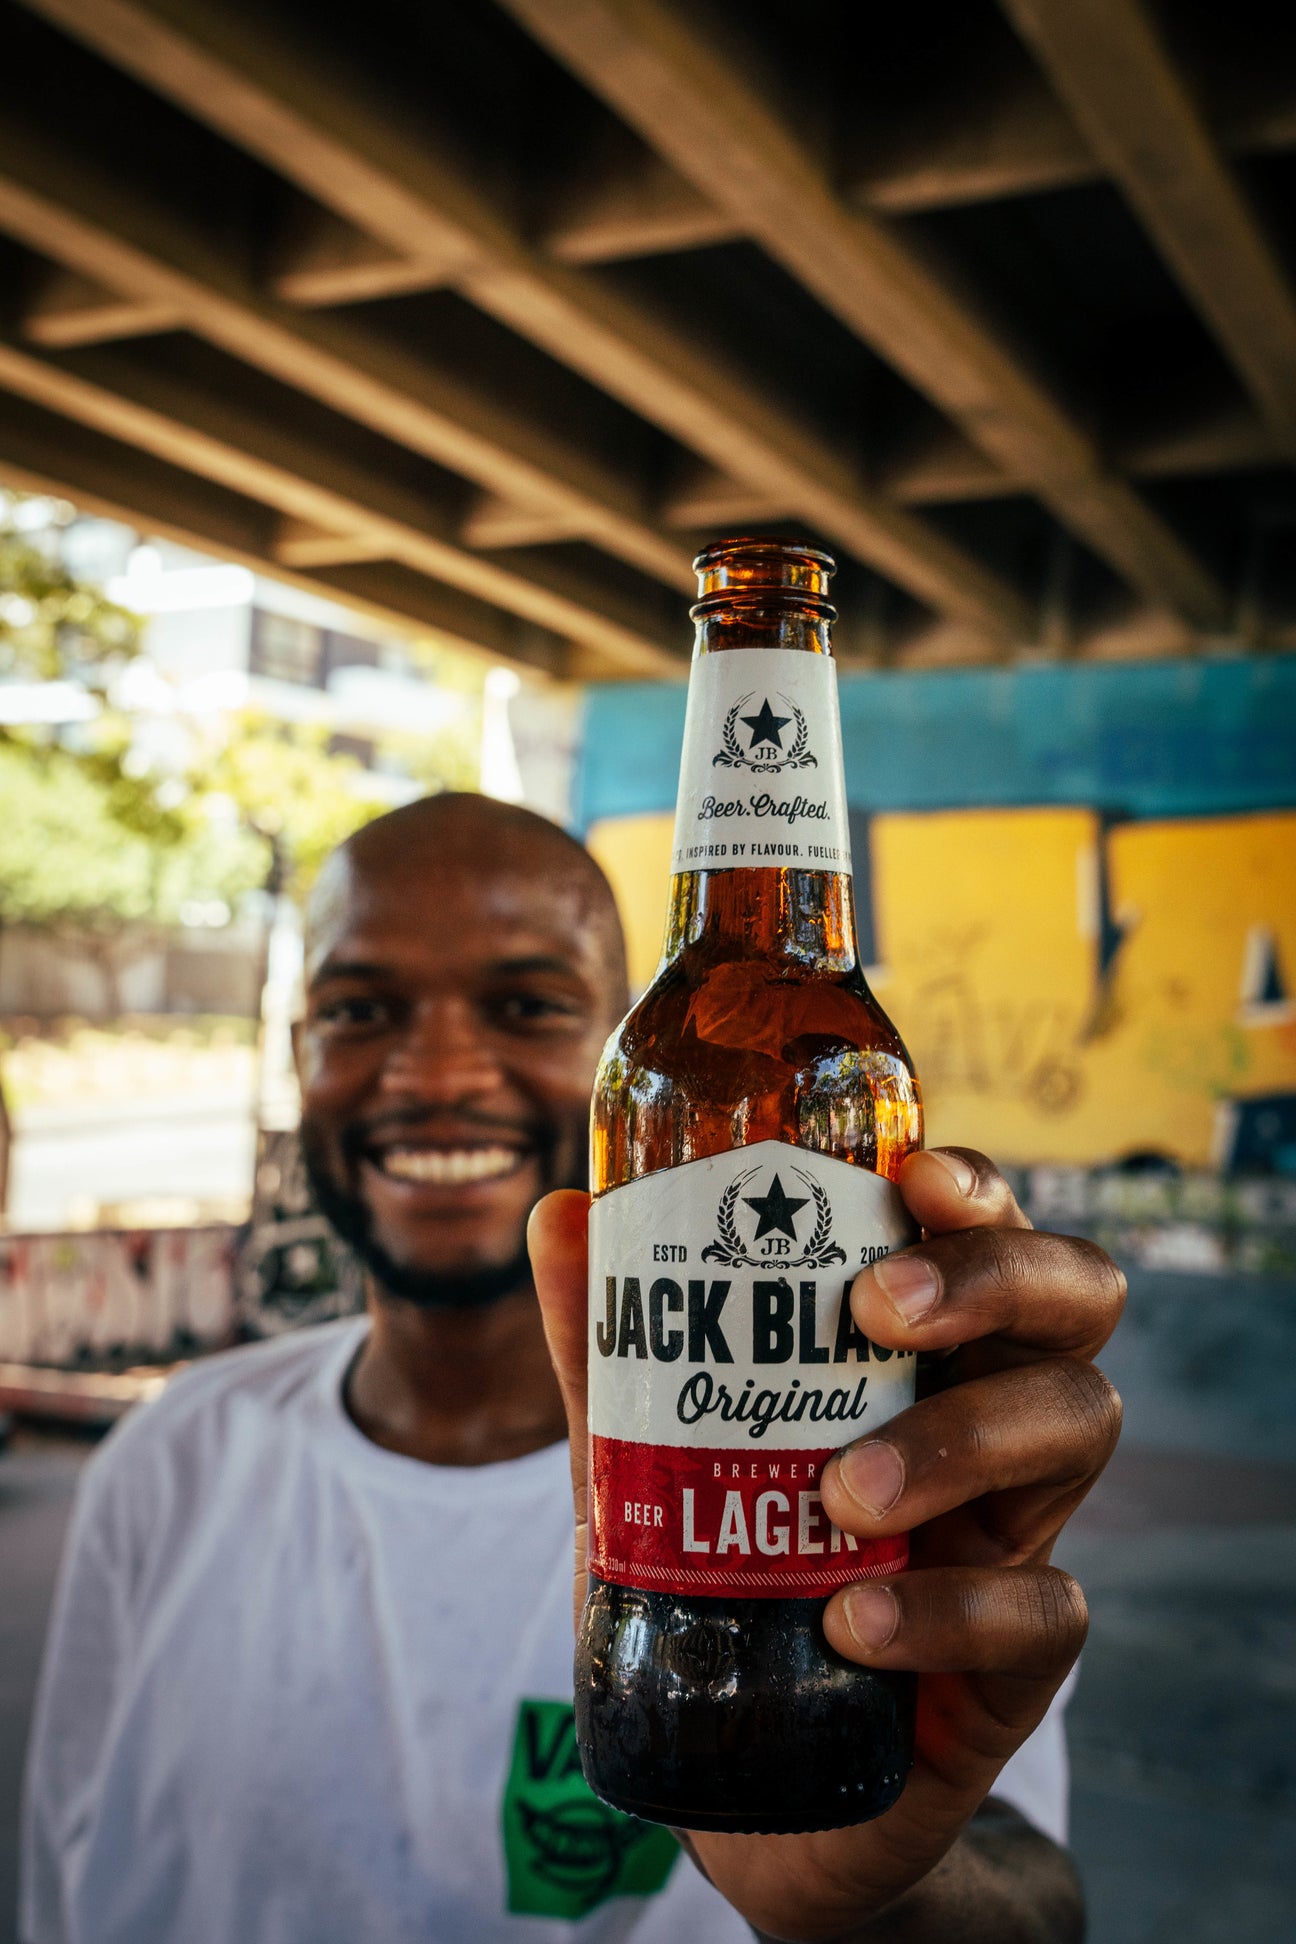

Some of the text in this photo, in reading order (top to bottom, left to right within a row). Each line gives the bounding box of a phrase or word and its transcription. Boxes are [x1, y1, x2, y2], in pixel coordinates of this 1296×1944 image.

[755, 747, 778, 760] JB
[686, 844, 727, 859] INSPIRED
[732, 843, 746, 856] BY
[751, 843, 803, 857] FLAVOUR.
[653, 1244, 687, 1263] ESTD
[760, 1238, 791, 1255] JB
[596, 1275, 914, 1364] JACK BLA
[676, 1371, 868, 1438] Original
[713, 1463, 816, 1479] BREWER
[624, 1501, 664, 1527] BEER
